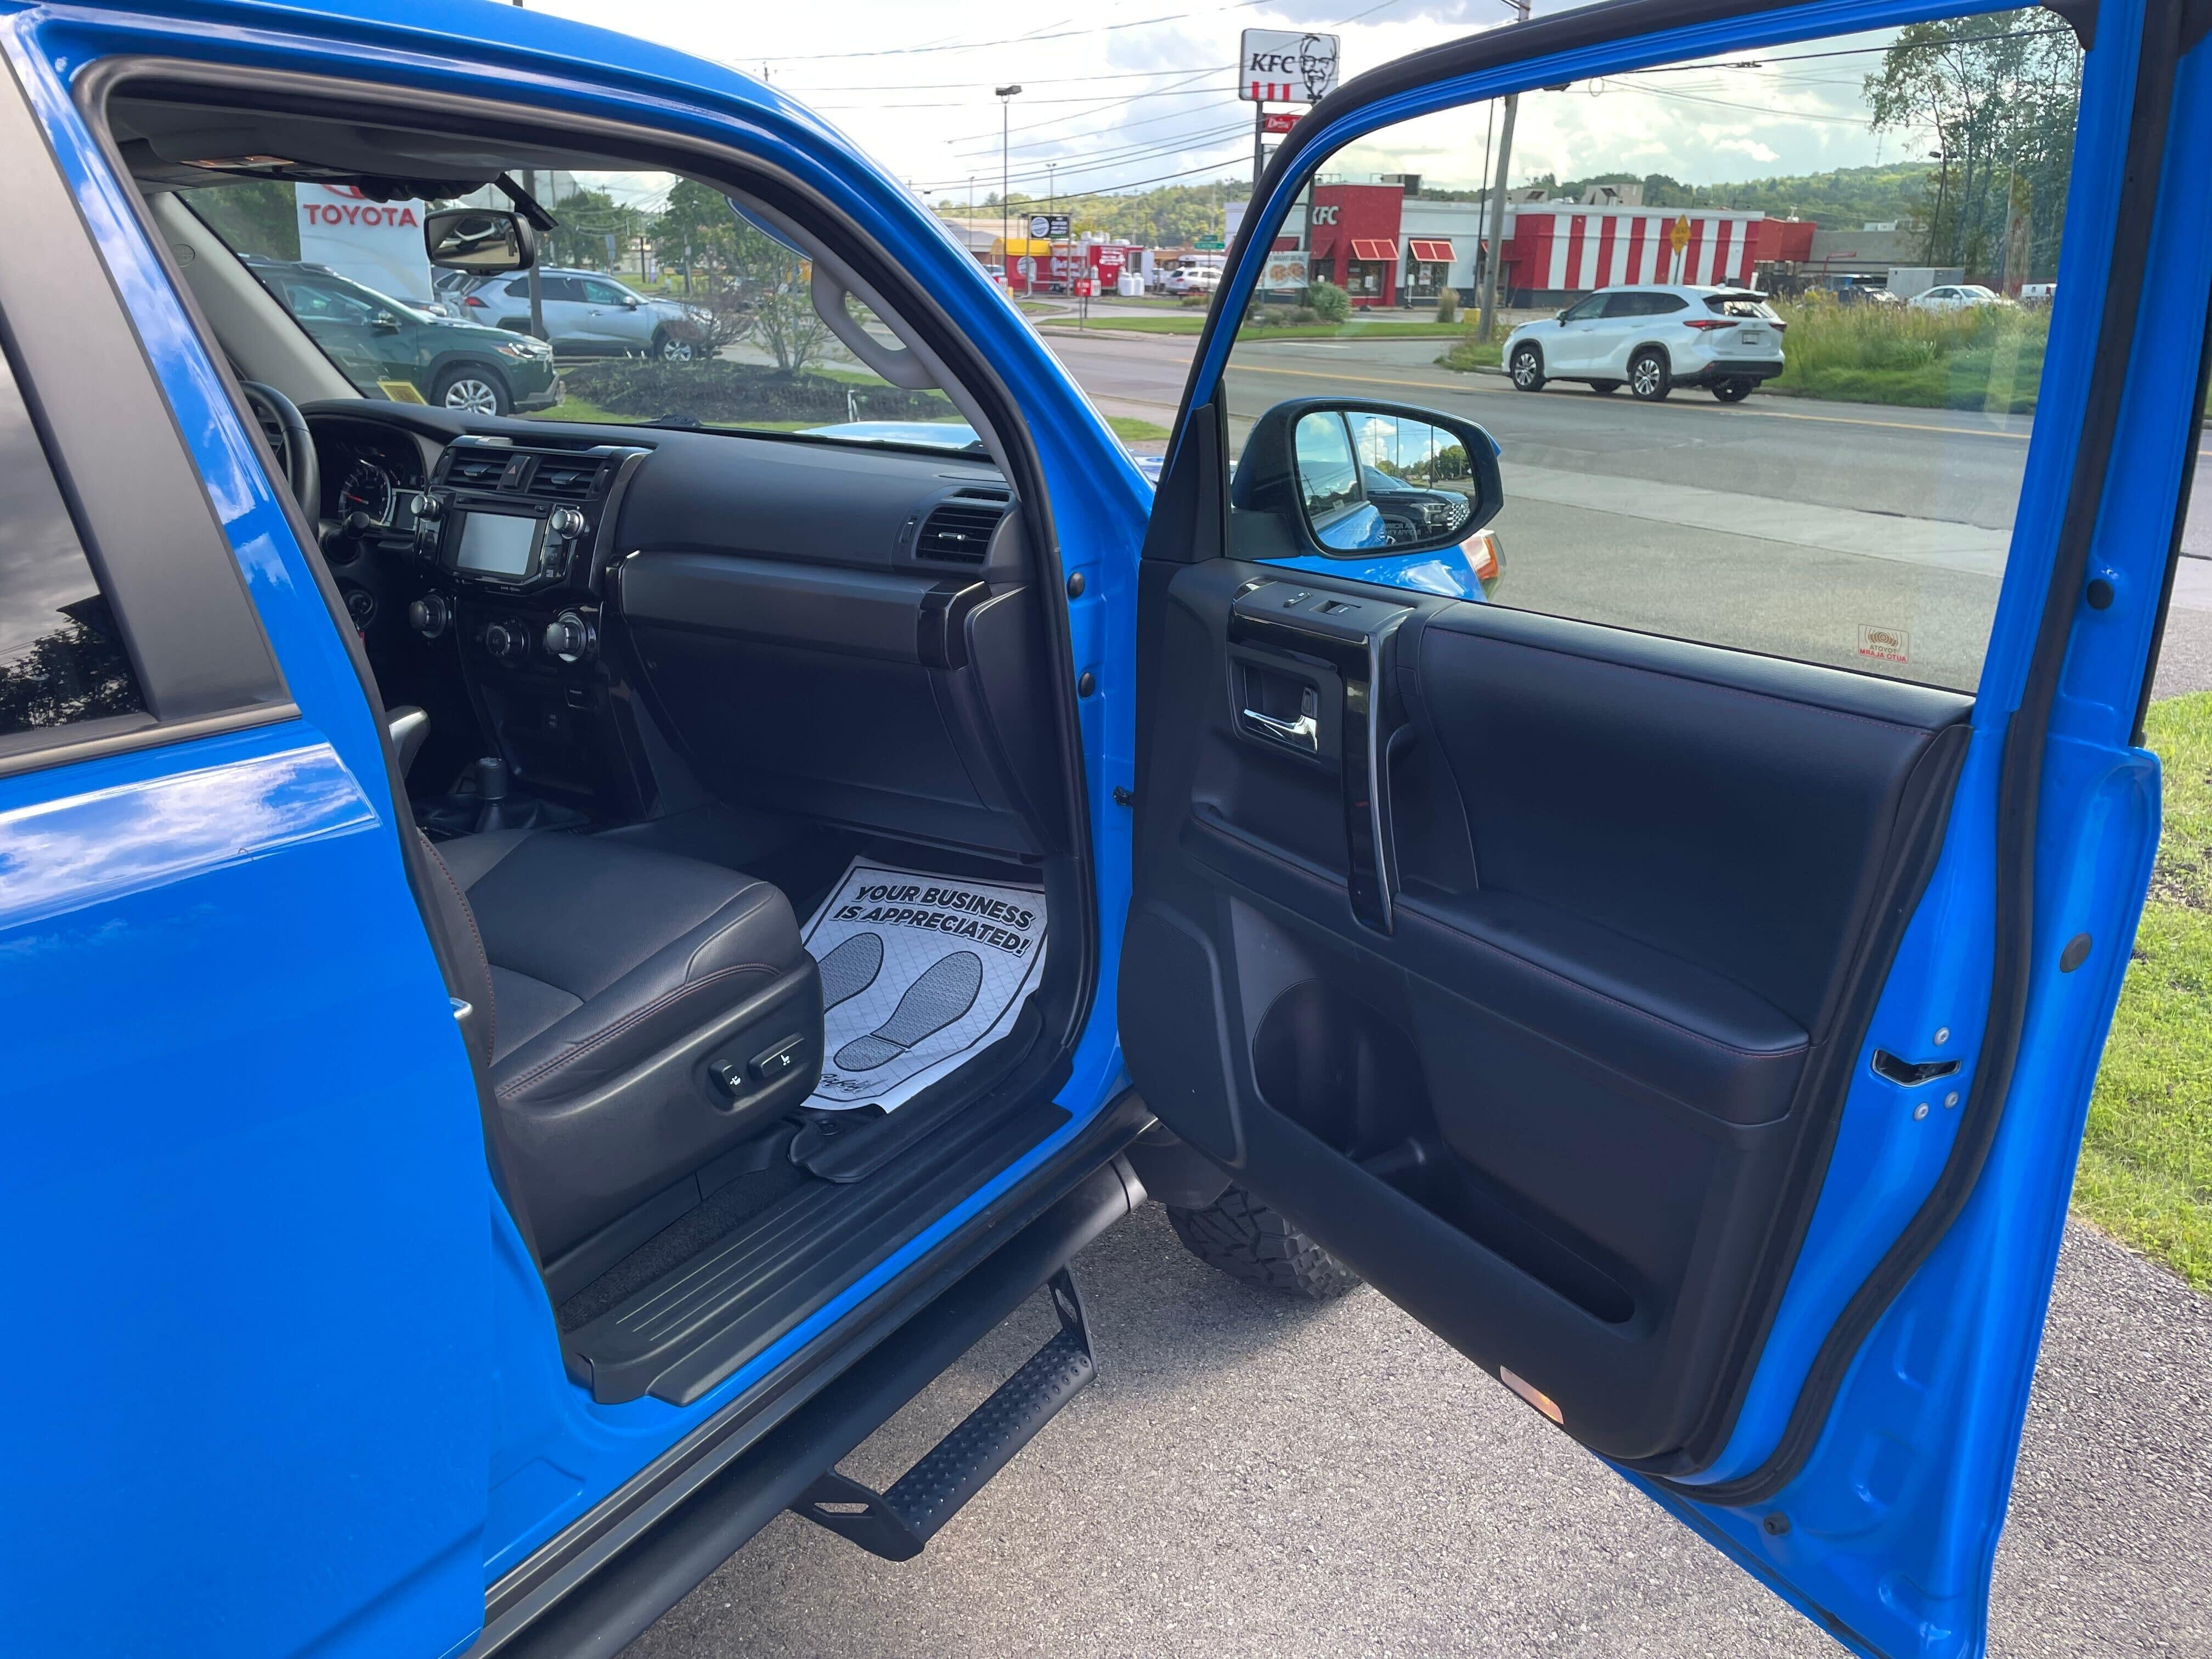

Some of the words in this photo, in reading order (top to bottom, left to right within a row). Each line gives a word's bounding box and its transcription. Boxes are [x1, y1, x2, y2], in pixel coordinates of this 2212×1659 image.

[1250, 53, 1295, 74] KFC
[303, 203, 417, 228] TOYOTA
[1312, 206, 1339, 225] KFC
[854, 884, 921, 902] YOUR
[920, 888, 1037, 930] BUSINESS
[831, 904, 864, 921] IS
[864, 907, 1033, 958] APPRECIATED!
